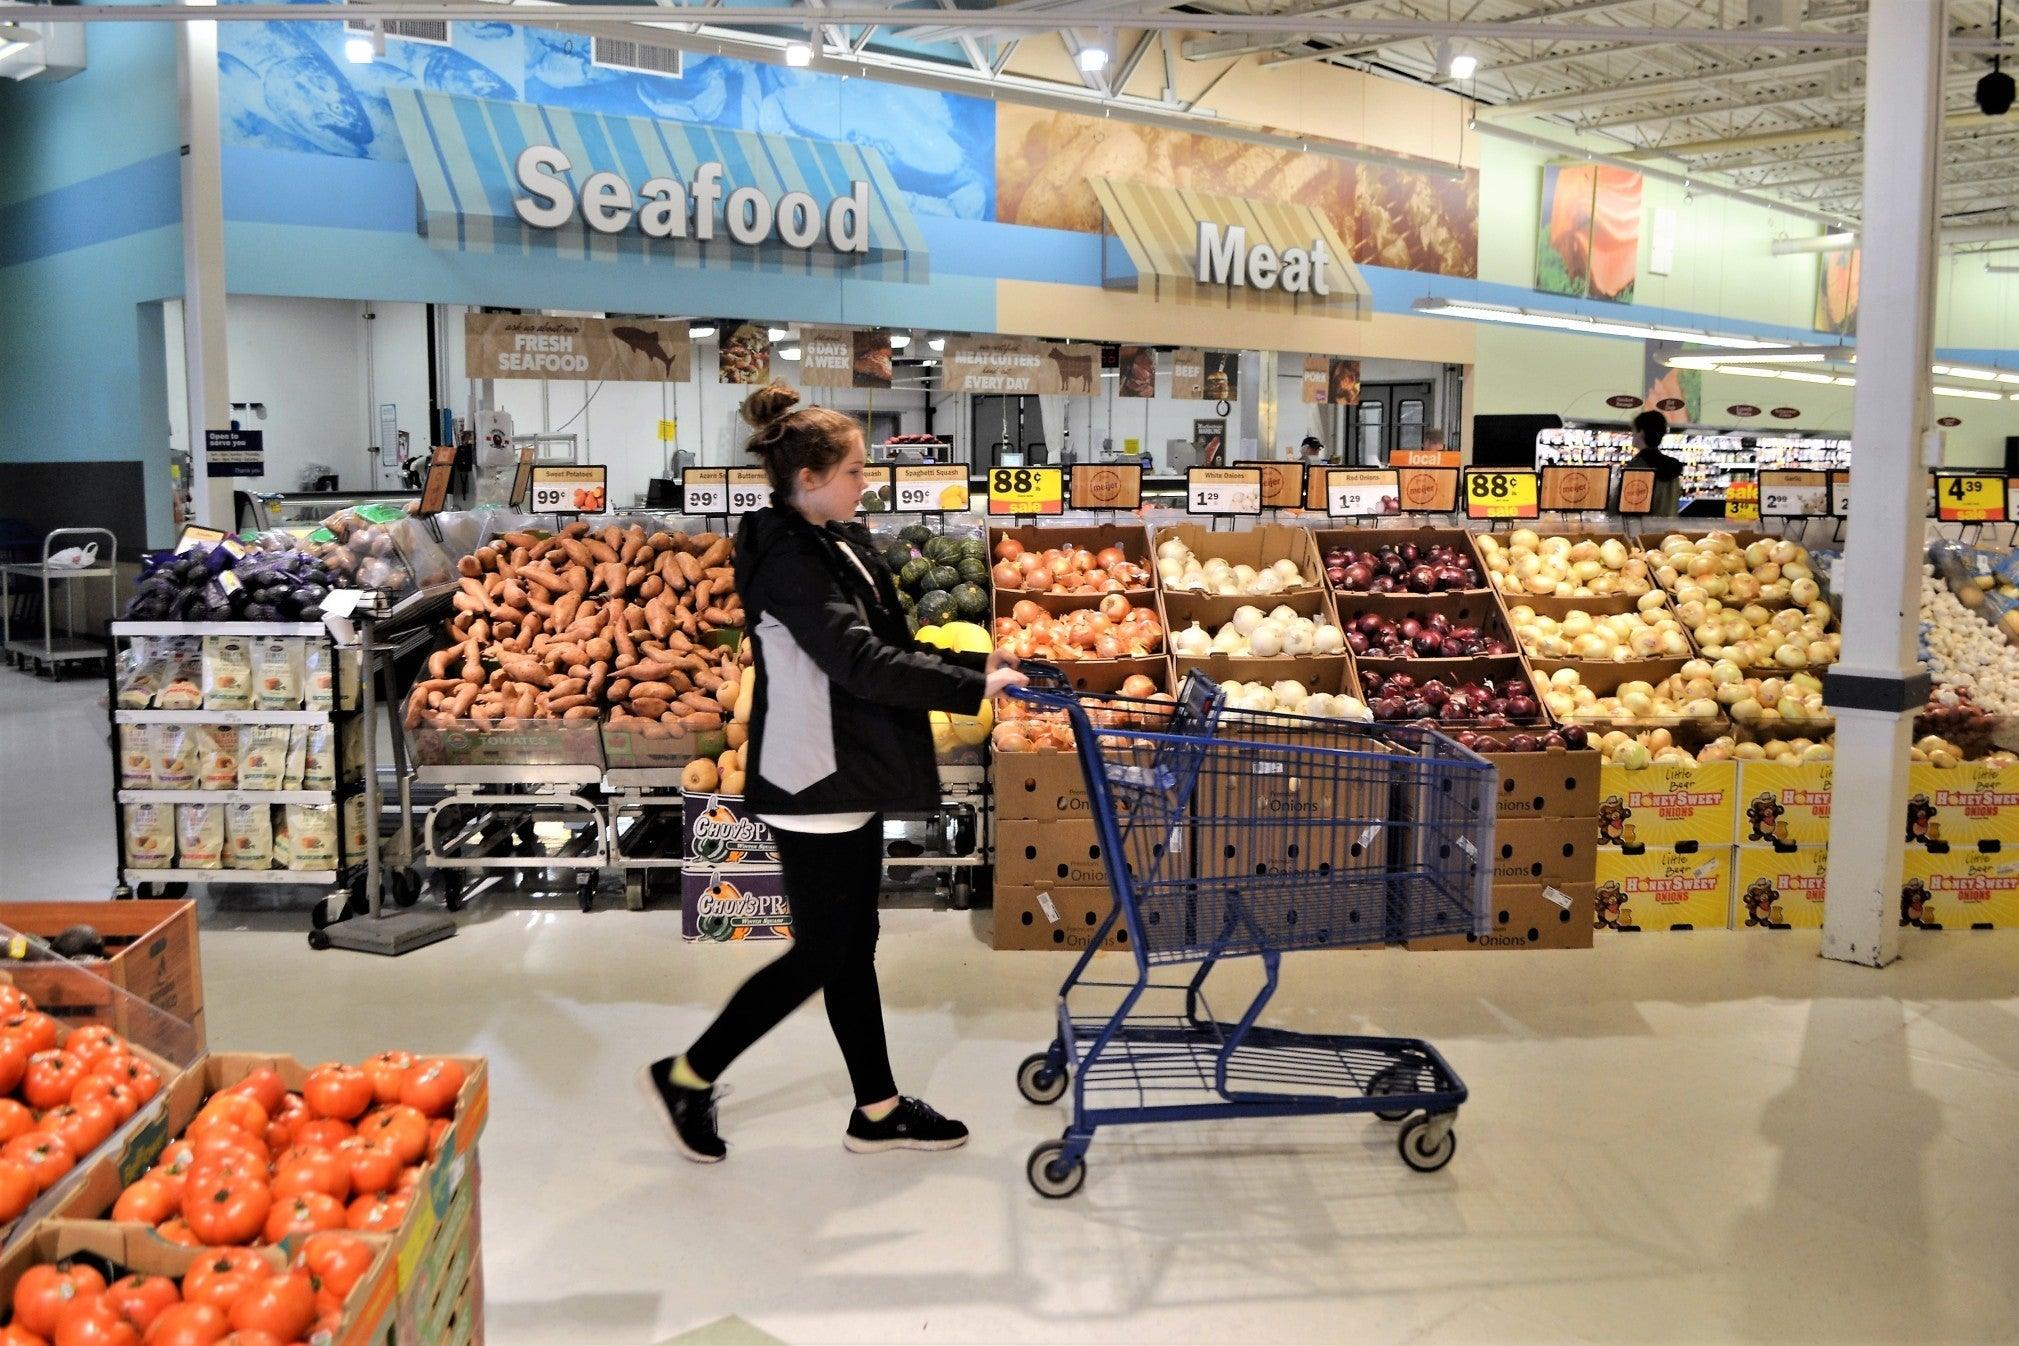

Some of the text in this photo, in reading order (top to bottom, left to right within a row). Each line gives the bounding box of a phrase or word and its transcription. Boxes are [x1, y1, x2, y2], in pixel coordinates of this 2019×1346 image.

[514, 145, 869, 253] Seafood
[1196, 220, 1329, 296] Meat
[515, 334, 573, 352] FRESH
[807, 342, 848, 356] 6 DAYS
[498, 353, 589, 371] SEAFOOD
[804, 355, 850, 369] A WEEK
[954, 351, 988, 366] MEAT
[1175, 365, 1201, 378] BEEF
[964, 375, 1030, 391] EVERY DAY
[232, 440, 247, 448] you
[1408, 452, 1442, 466] local
[1094, 482, 1119, 491] meijer
[1409, 484, 1435, 495] meijer
[1008, 501, 1042, 514] sale
[480, 736, 549, 747] TOMATES
[1665, 766, 1693, 781] Little
[1973, 767, 2000, 781] Little
[1669, 780, 1696, 793] Bear
[1975, 781, 2002, 793] Bear
[1270, 798, 1318, 812] Onions
[1496, 800, 1531, 811] nions
[1964, 806, 1999, 817] ONIONS
[1659, 806, 1695, 818] ONIONS
[1661, 851, 1689, 867] Little
[1493, 865, 1529, 877] nions
[1665, 864, 1692, 878] Bear
[1968, 865, 1994, 876] Bear
[1655, 891, 1690, 903] ONIONS
[1958, 890, 1992, 901] ONIONS
[1478, 934, 1526, 947] Onions
